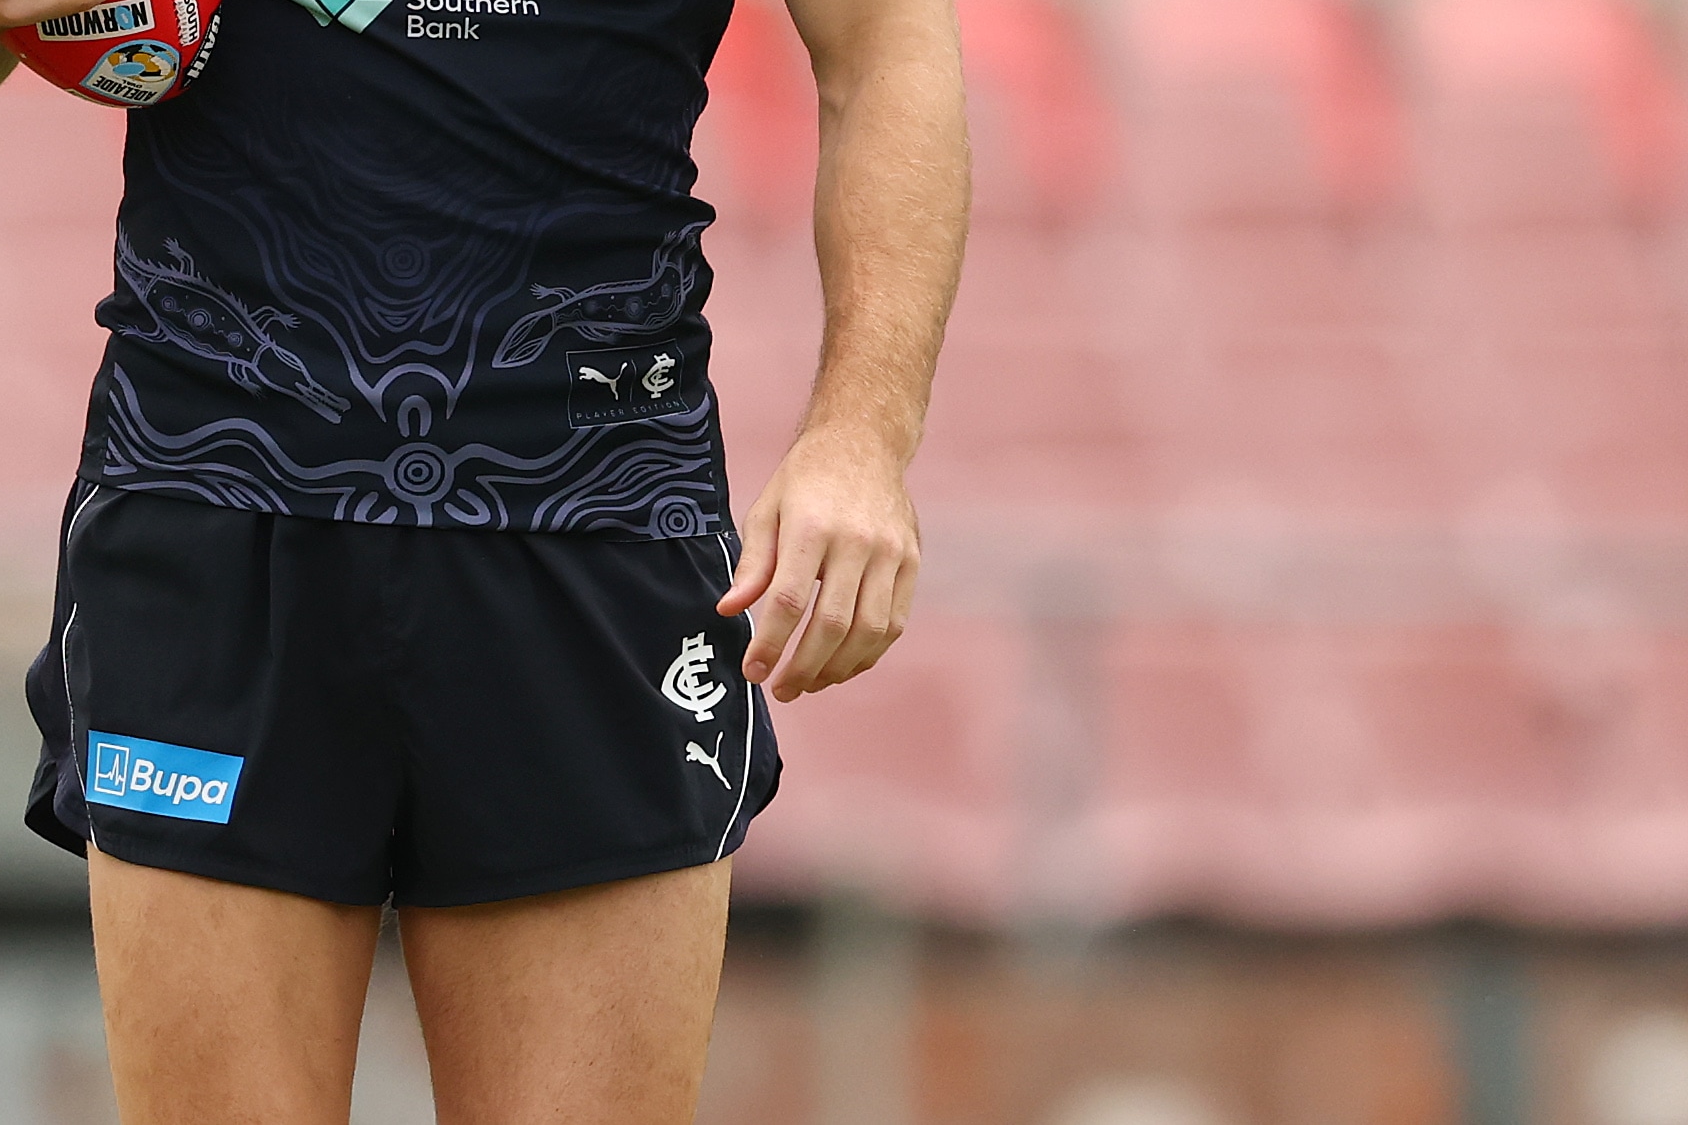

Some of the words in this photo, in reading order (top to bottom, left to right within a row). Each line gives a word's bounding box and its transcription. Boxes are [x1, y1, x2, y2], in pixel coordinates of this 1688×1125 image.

[407, 15, 480, 41] Bank
[92, 74, 158, 103] ADELAIDE
[575, 408, 626, 421] PLAYER
[632, 400, 681, 415] EDITION
[129, 758, 229, 805] Bupa
